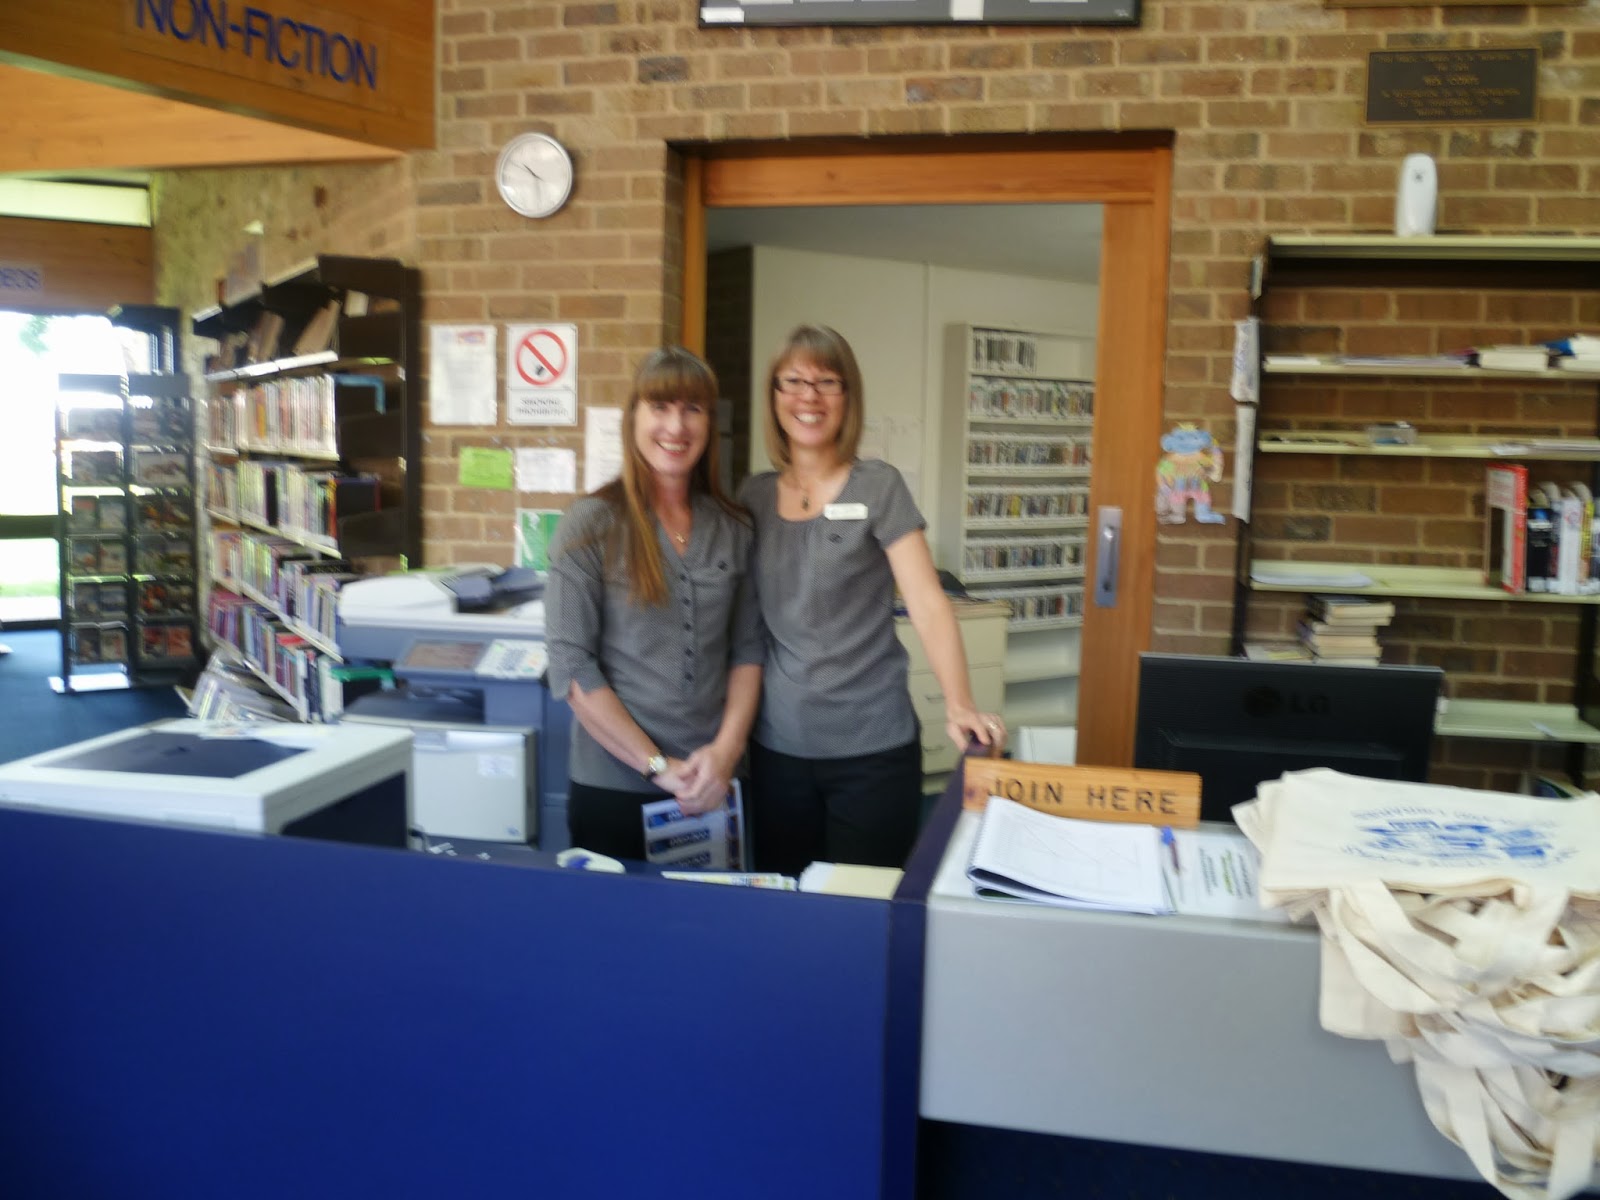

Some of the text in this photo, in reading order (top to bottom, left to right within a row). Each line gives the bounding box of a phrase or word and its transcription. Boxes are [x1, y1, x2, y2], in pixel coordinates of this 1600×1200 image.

[136, 0, 377, 90] NON-FICTION
[988, 778, 1179, 816] JOIN HERE
